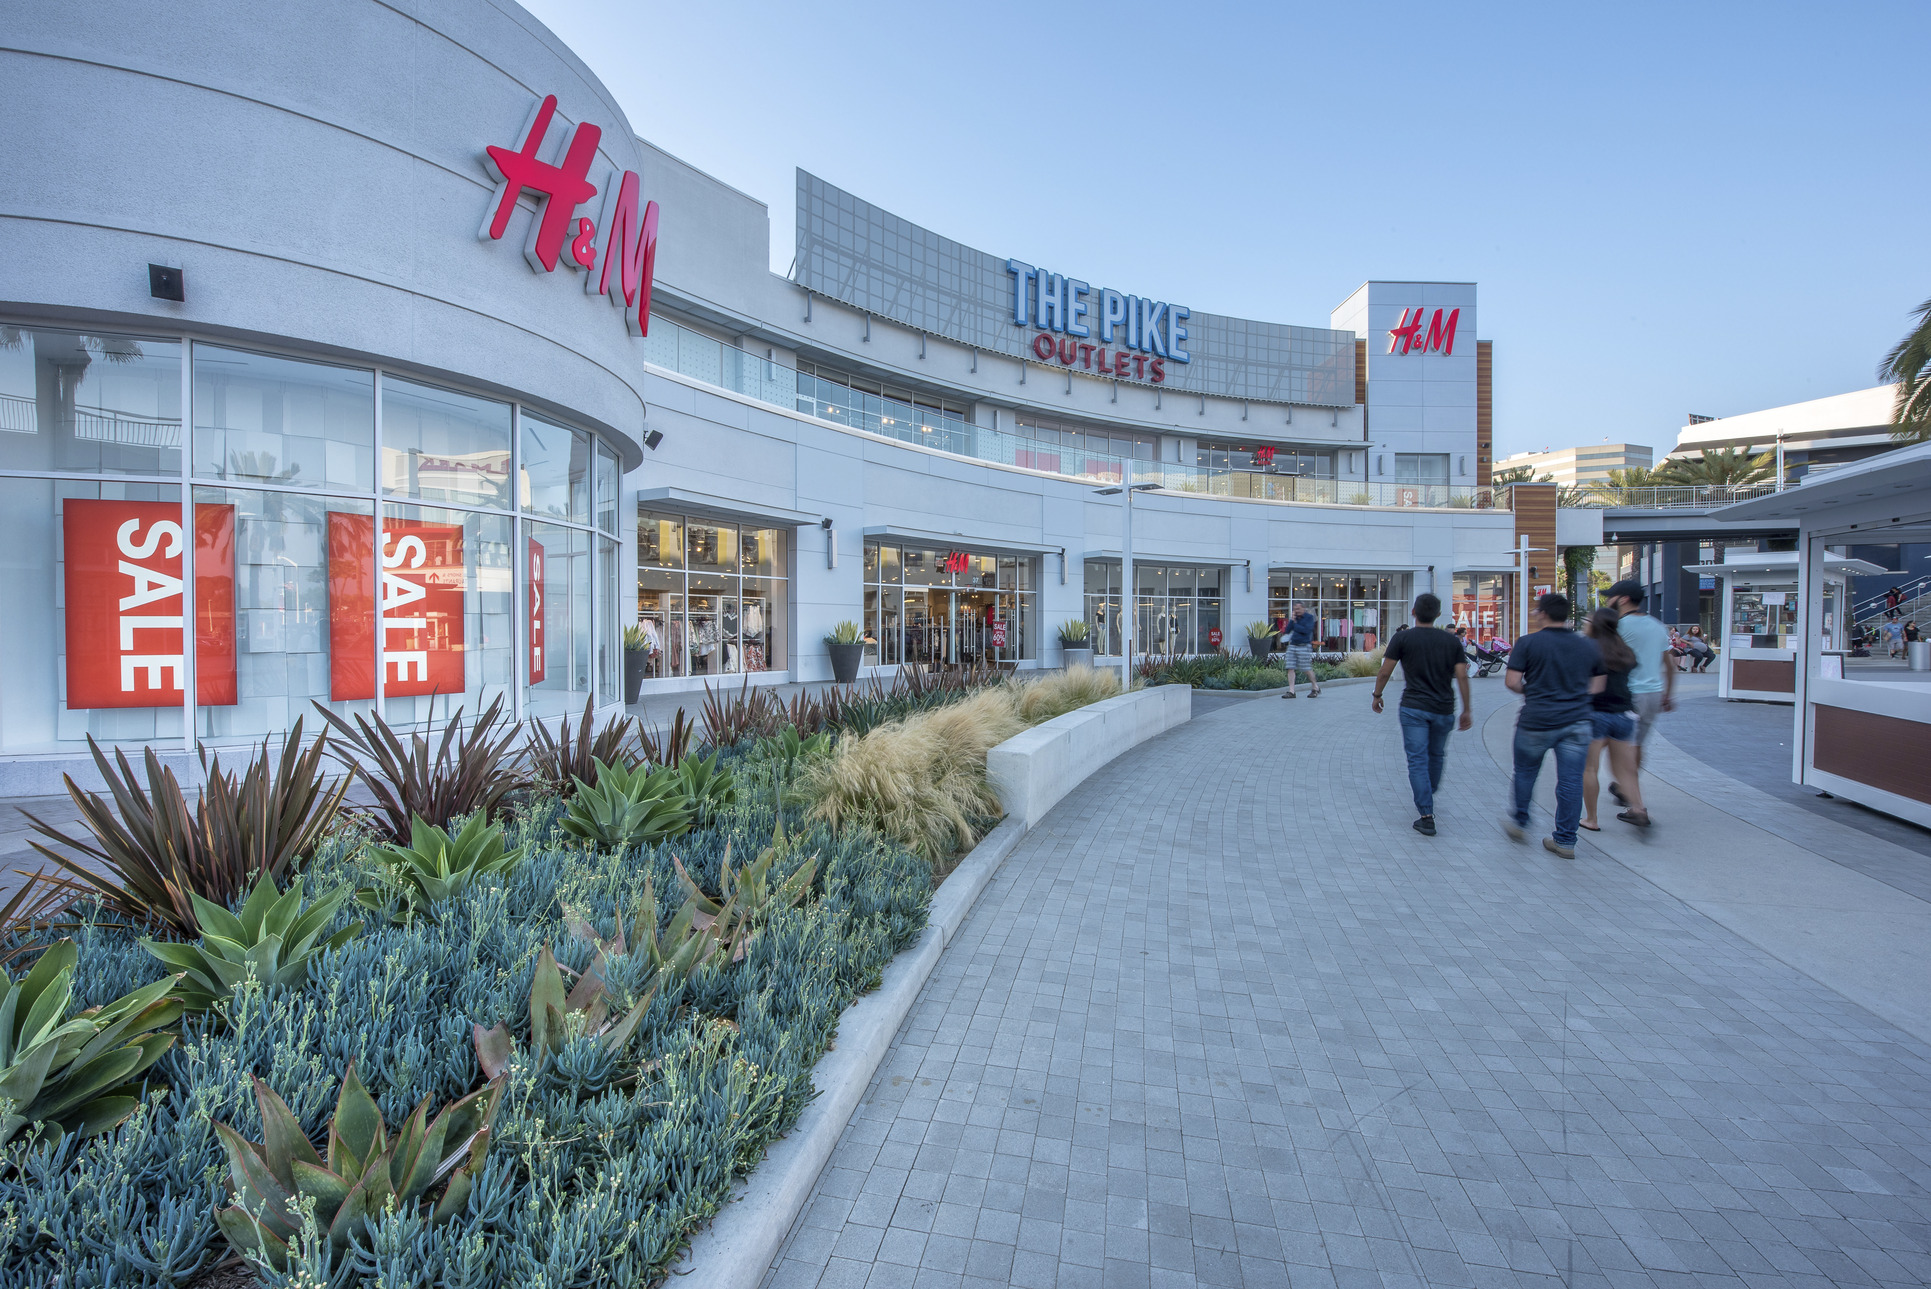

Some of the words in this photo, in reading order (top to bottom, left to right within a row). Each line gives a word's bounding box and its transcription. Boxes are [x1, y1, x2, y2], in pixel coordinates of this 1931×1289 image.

[480, 94, 660, 338] H&M
[1007, 258, 1090, 338] THE
[1101, 287, 1190, 364] PIKE
[1034, 333, 1165, 383] OUTLETS
[1387, 307, 1460, 356] H&M
[117, 518, 185, 692] SALE
[383, 532, 428, 684] SALE
[533, 553, 541, 673] SALE
[946, 552, 970, 575] H&M
